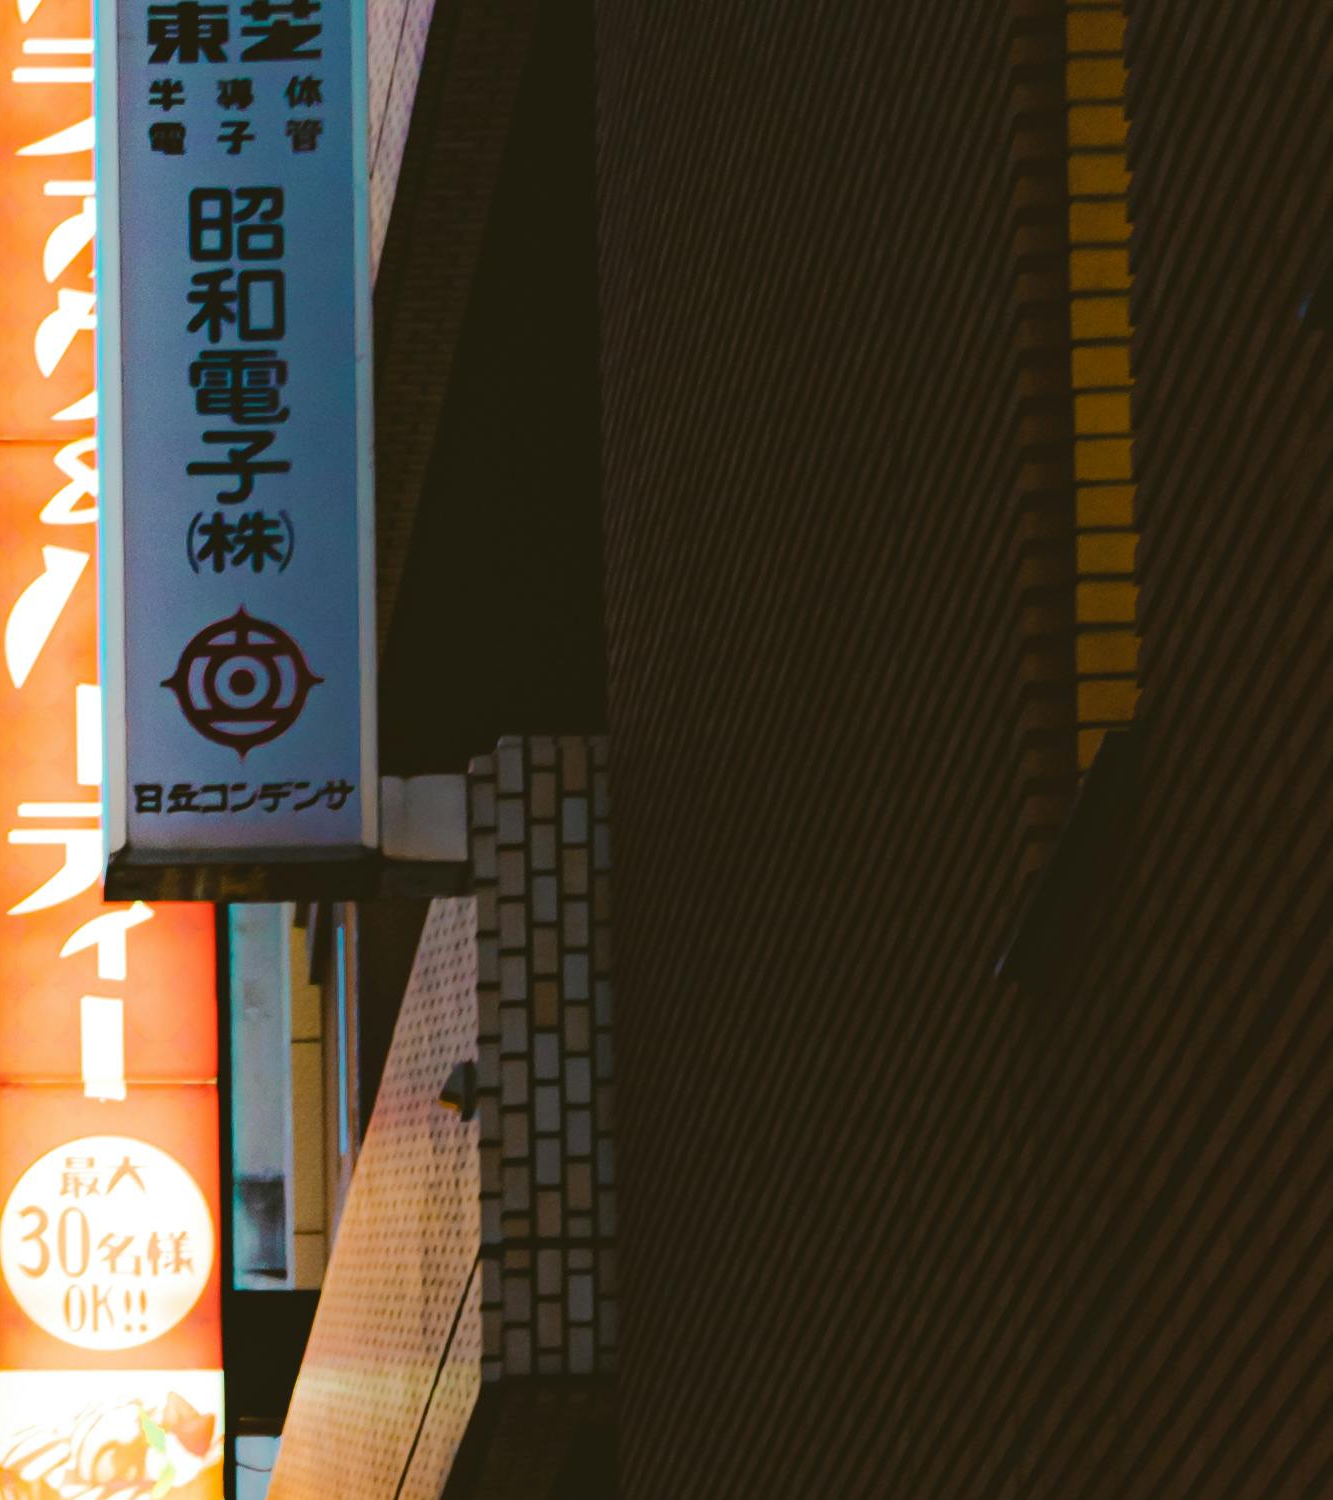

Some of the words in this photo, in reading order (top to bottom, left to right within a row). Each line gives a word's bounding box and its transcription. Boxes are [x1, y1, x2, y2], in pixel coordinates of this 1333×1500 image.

[148, 2, 322, 64] 東芝
[134, 782, 355, 816] 日立コンデンサ
[59, 1157, 146, 1196] 最大
[17, 1205, 195, 1280] 30名様
[64, 1285, 149, 1332] OK!!
